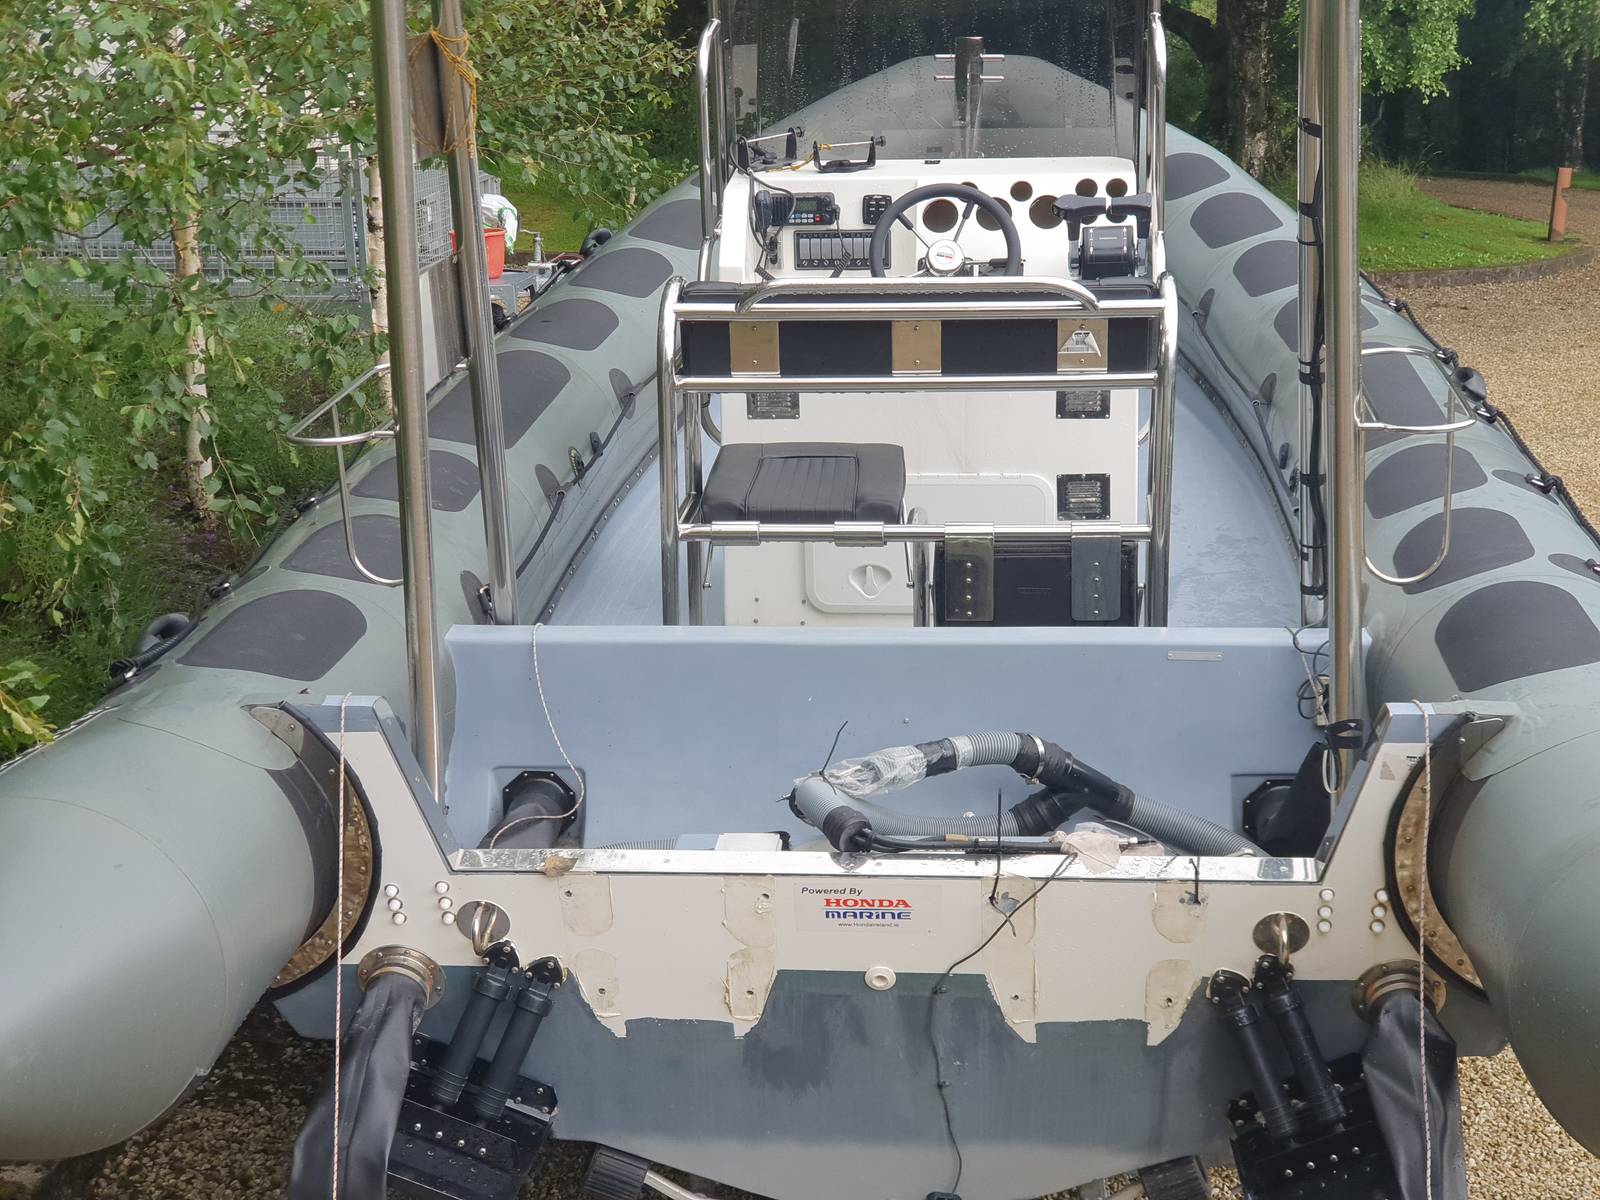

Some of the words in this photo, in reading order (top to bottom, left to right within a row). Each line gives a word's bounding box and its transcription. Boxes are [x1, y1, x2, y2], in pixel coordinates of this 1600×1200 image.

[801, 887, 846, 895] Powered
[849, 887, 863, 896] By
[824, 898, 912, 908] HONDA
